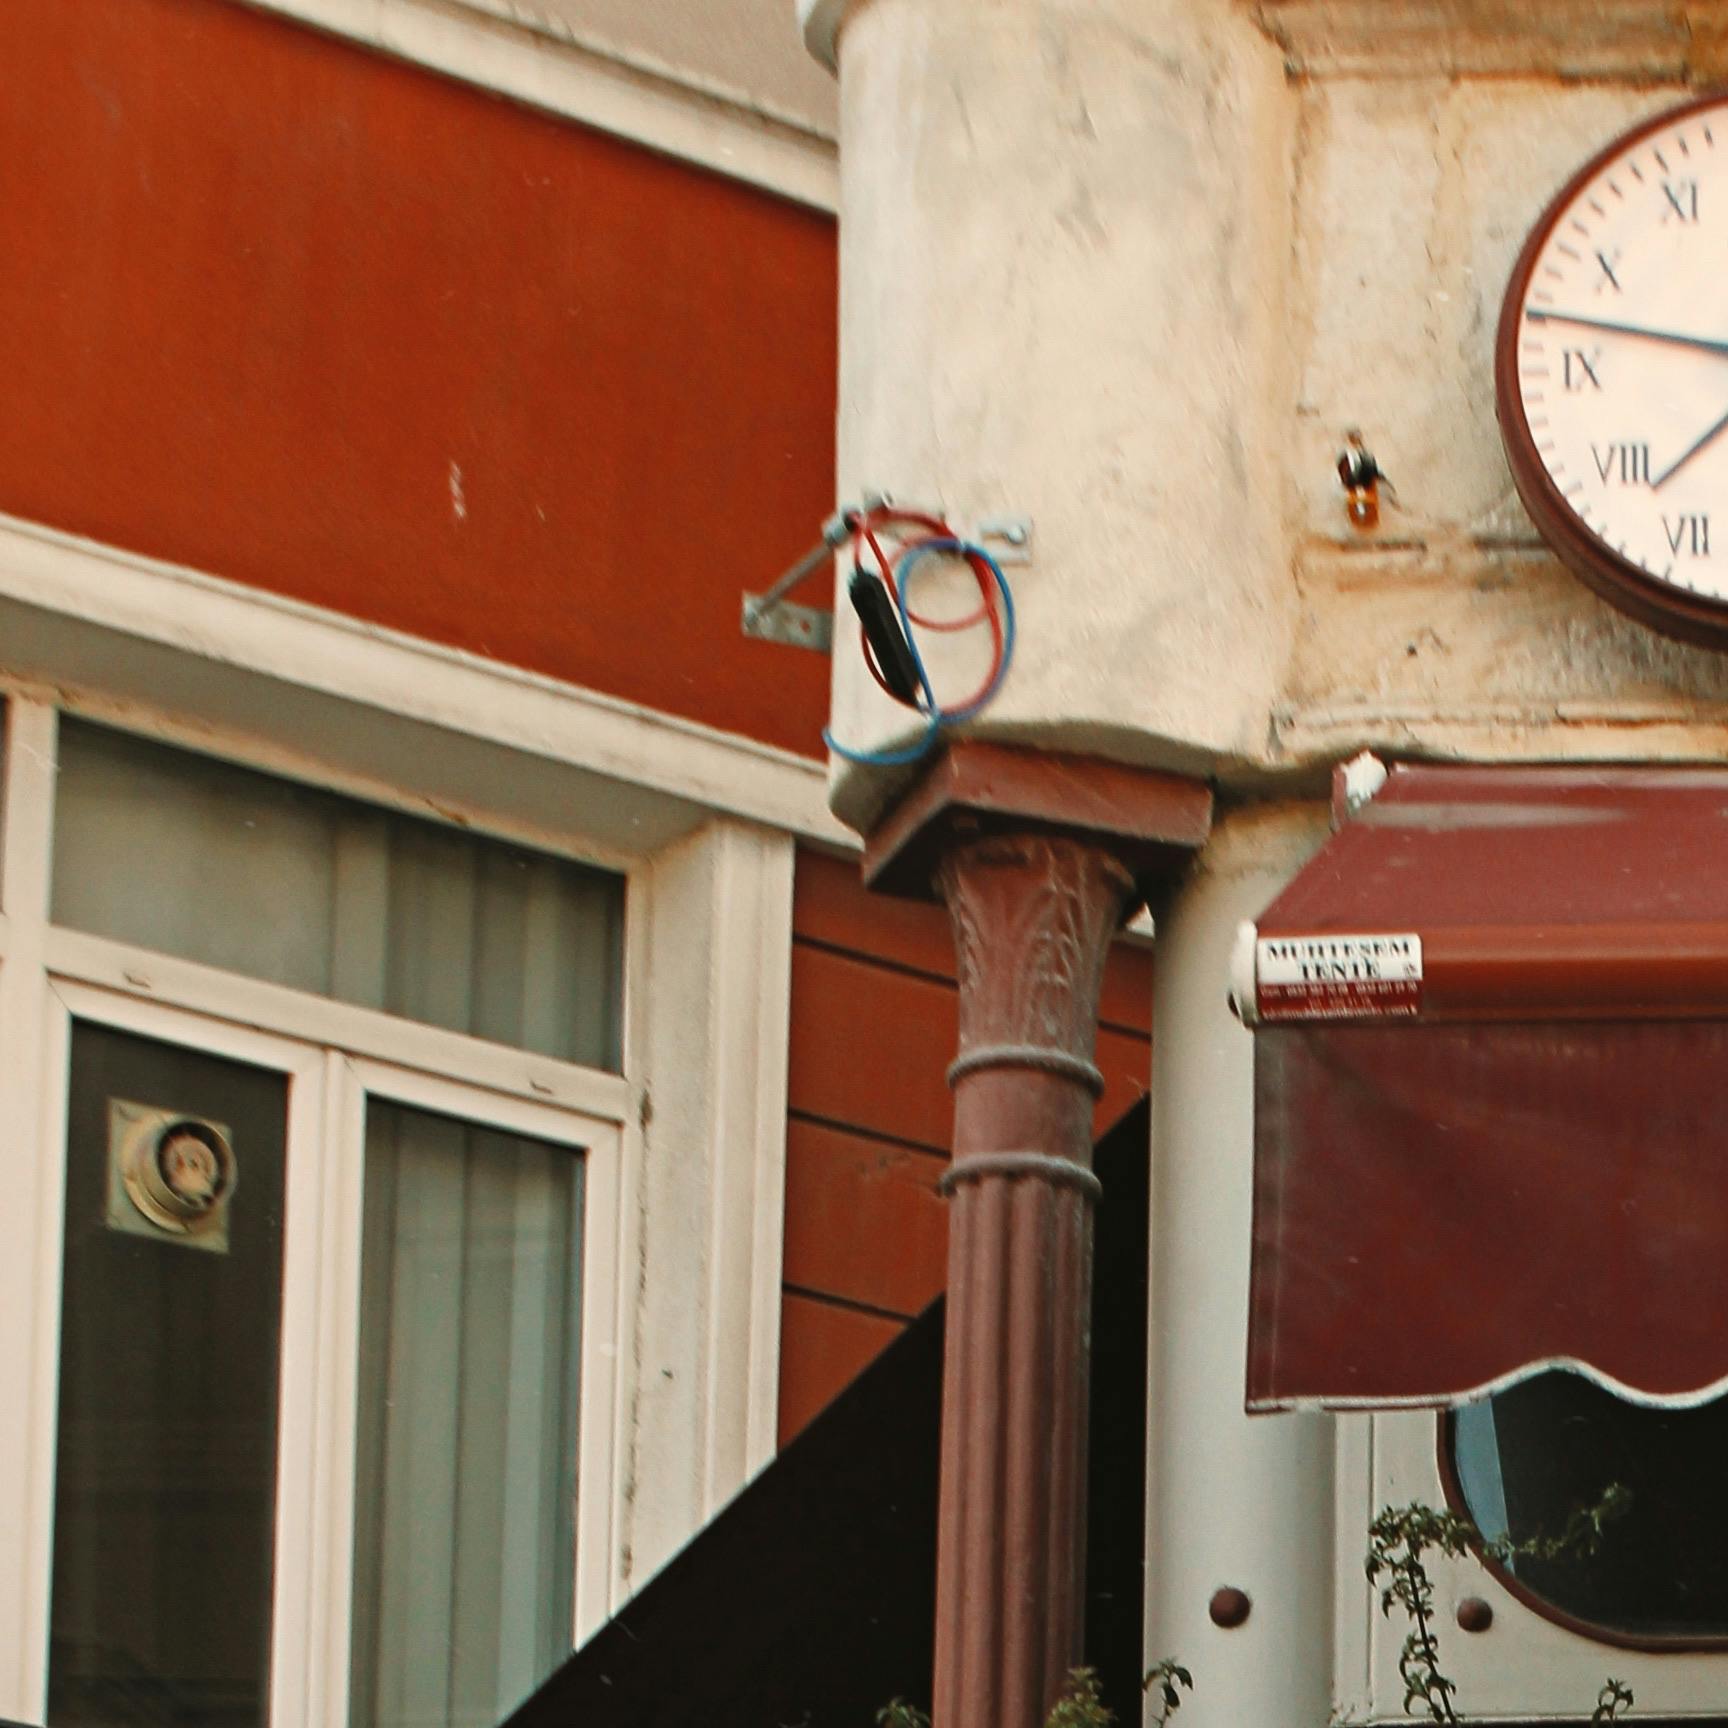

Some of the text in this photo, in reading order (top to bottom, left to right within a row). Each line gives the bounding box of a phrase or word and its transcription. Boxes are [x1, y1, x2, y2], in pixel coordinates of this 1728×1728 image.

[1661, 180, 1700, 224] XI
[1594, 249, 1622, 293] X
[1562, 350, 1601, 390] IX
[1591, 444, 1652, 486] VIII
[1661, 515, 1710, 557] VII
[1299, 961, 1380, 981] TENTE
